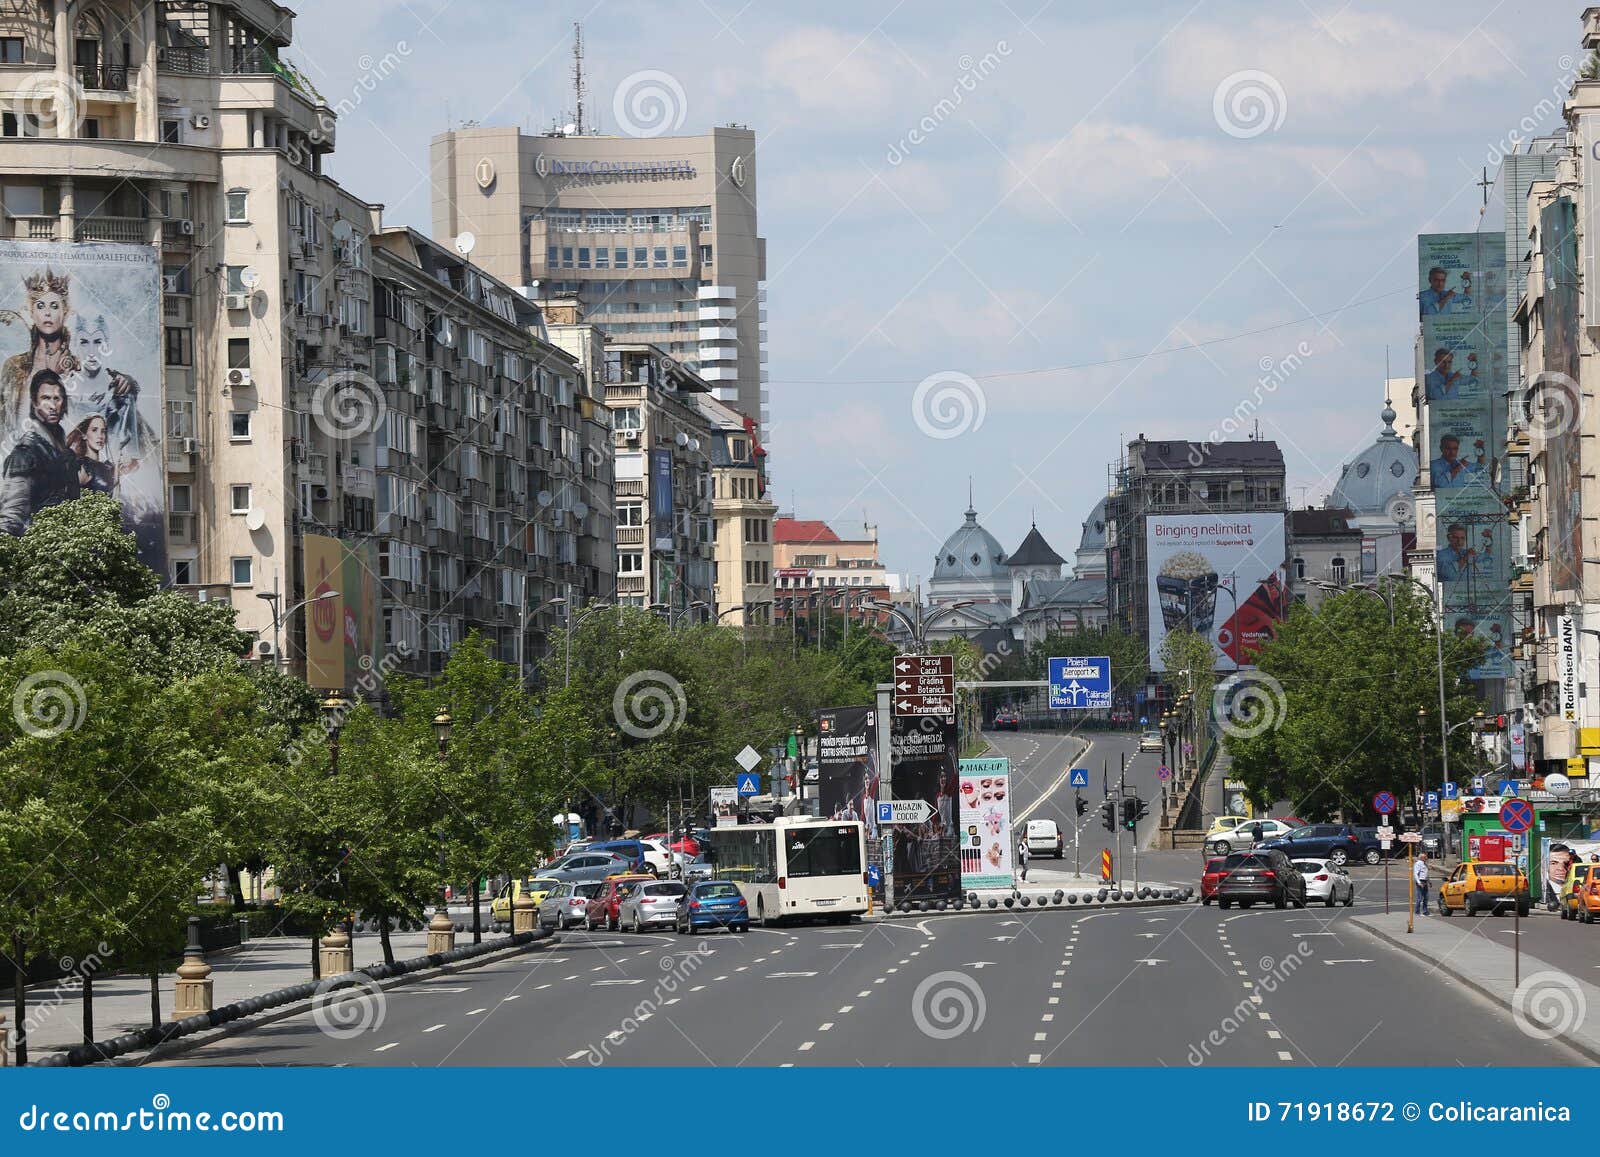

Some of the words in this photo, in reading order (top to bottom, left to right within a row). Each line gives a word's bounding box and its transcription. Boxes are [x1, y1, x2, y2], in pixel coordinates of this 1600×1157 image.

[96, 254, 148, 263] MALEFICENT
[1156, 524, 1198, 538] Binging
[1201, 523, 1252, 535] nelimitat
[920, 657, 940, 666] Parcul
[965, 763, 1002, 772] MAKE-UP
[1445, 783, 1453, 797] P
[881, 808, 889, 817] P
[893, 803, 922, 811] MAGAZIN
[896, 812, 918, 820] COCOR
